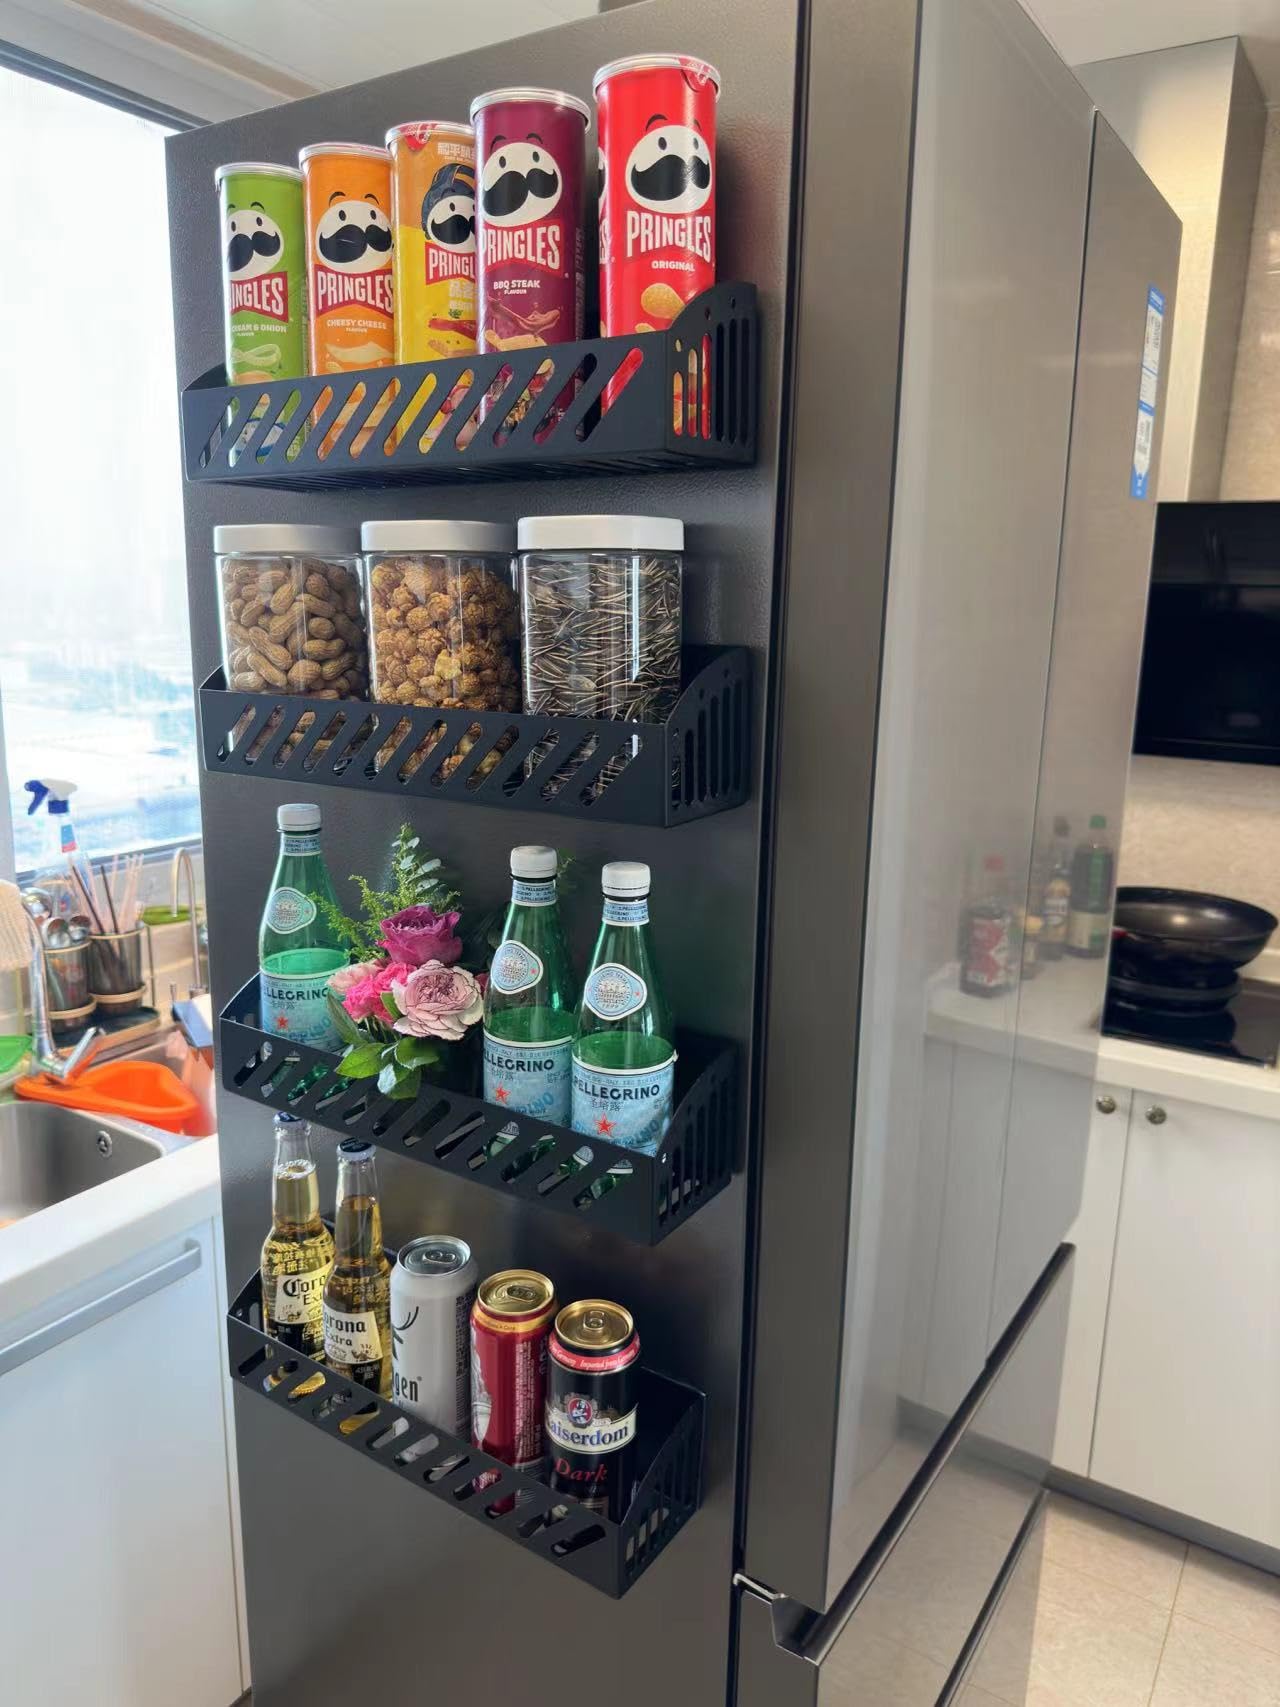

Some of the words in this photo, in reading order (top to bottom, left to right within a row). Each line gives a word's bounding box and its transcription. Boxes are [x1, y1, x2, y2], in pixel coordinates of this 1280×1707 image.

[627, 210, 712, 263] PRINGLES
[428, 247, 476, 279] PRINGL
[651, 260, 695, 272] ORIGINAL
[230, 277, 284, 316] INGLES
[317, 271, 393, 313] PRINGLES
[493, 280, 511, 290] BBQ
[511, 279, 541, 289] STEAK
[283, 1276, 326, 1297] Coro
[324, 1312, 367, 1333] orona
[551, 1420, 629, 1446] aiserdom
[556, 1458, 608, 1483] Dark
